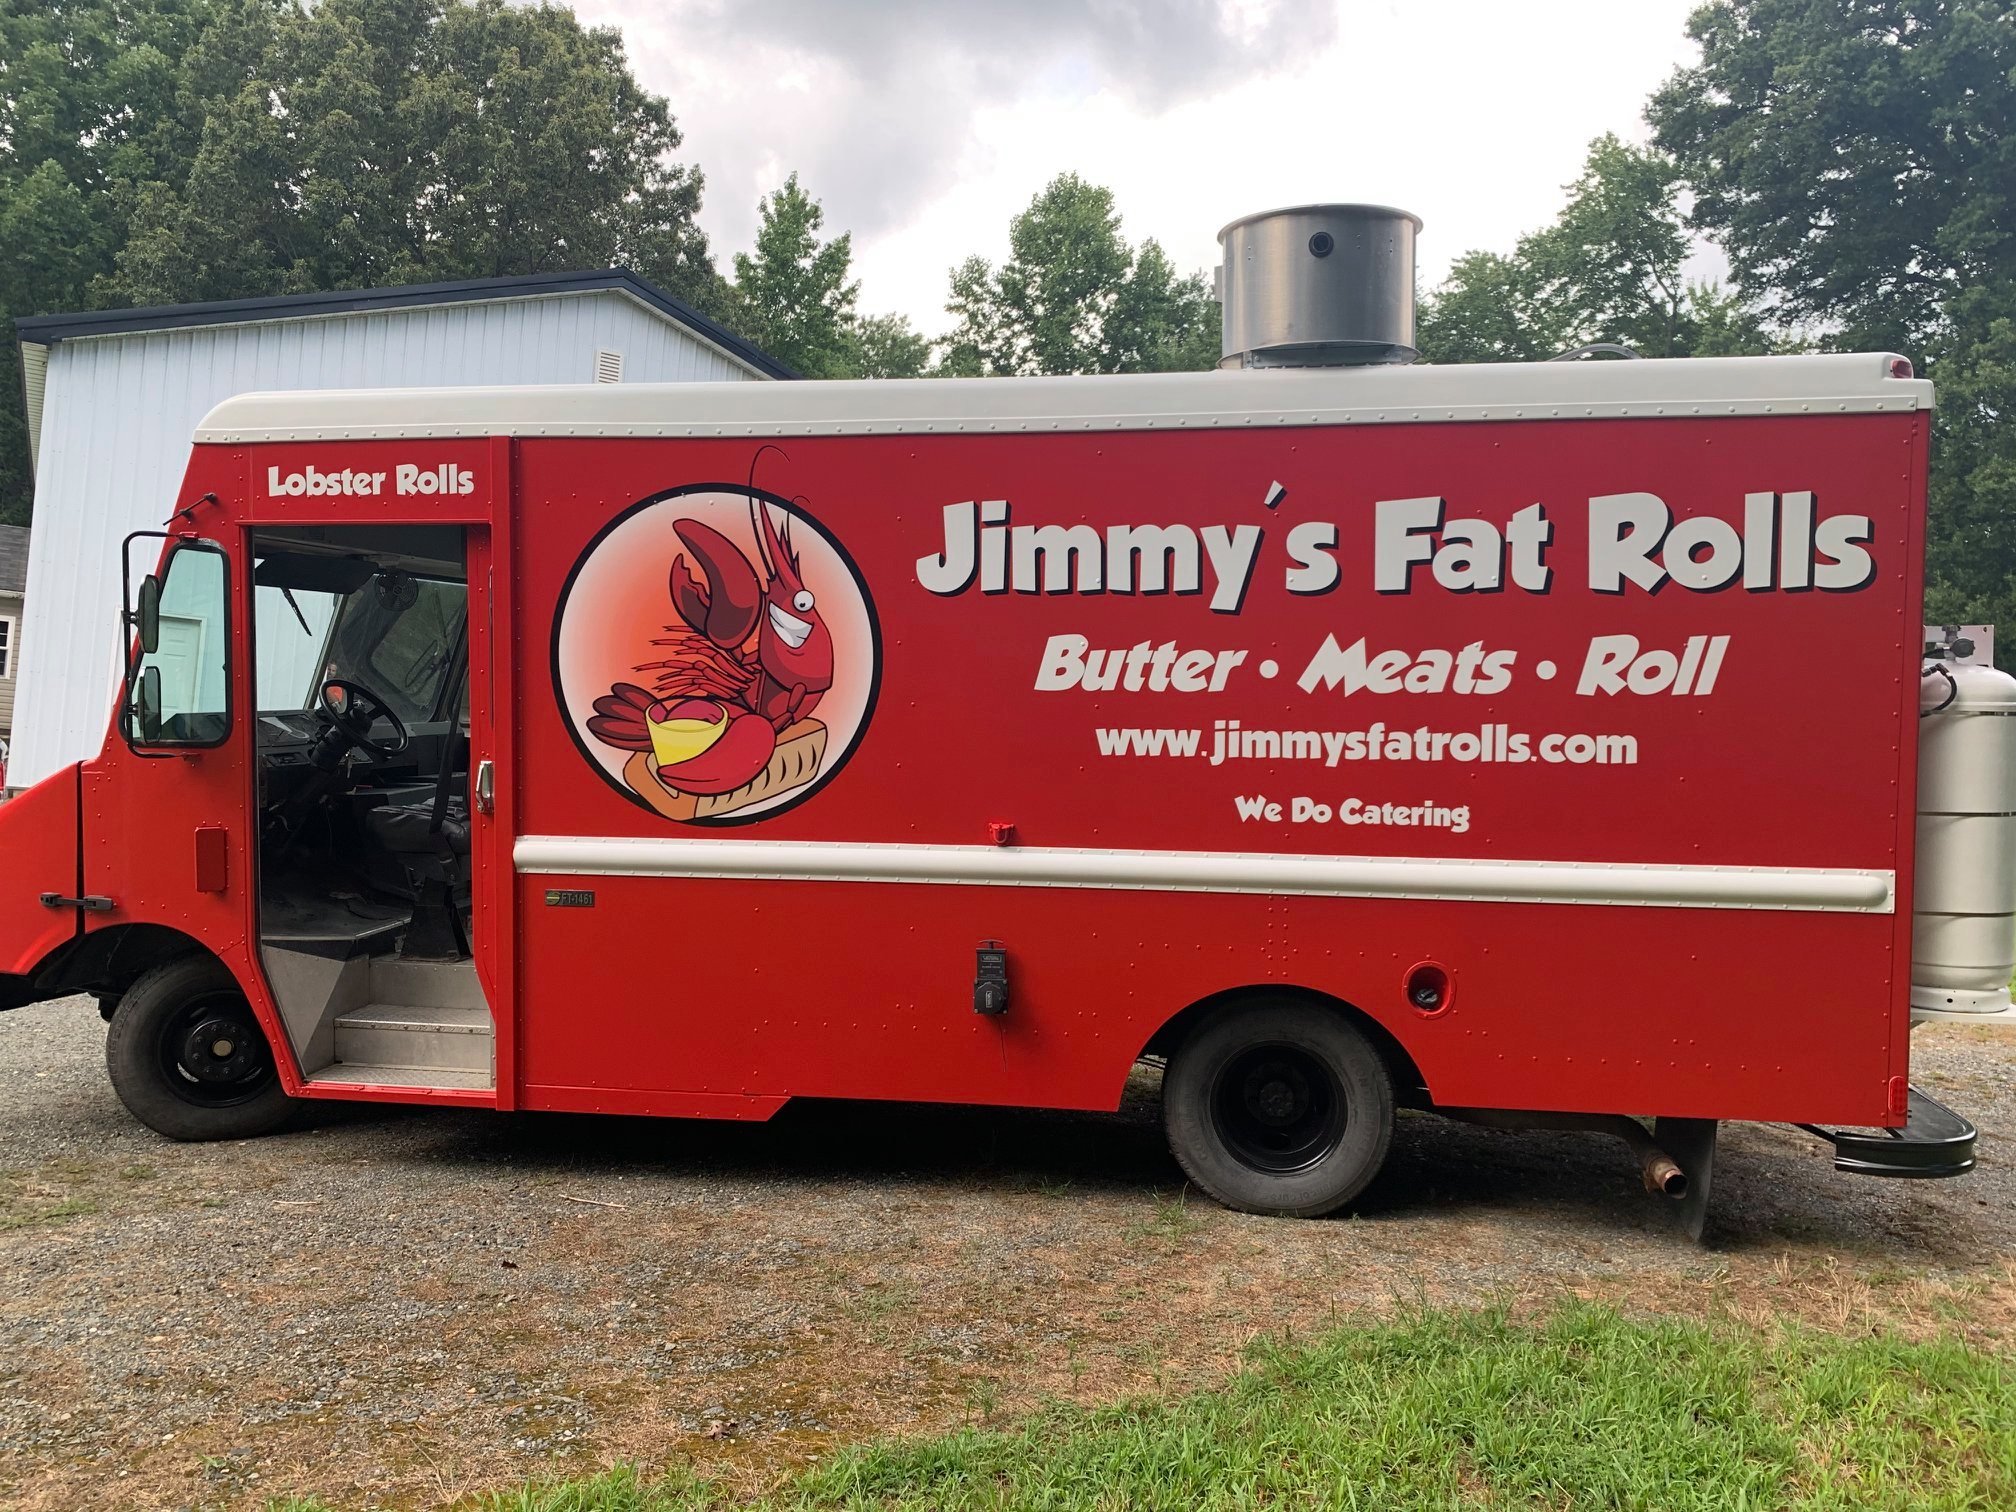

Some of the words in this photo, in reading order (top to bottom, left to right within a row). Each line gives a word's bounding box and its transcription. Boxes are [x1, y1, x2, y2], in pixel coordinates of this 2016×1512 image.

[267, 464, 387, 498] Lobster
[395, 463, 475, 496] Rolls
[915, 480, 1341, 613] Jimmy's
[1374, 496, 1552, 594] Fat
[1587, 490, 1875, 593] Rolls
[1034, 633, 1249, 693] Butter
[1296, 632, 1518, 698] Meats
[1575, 634, 1731, 697] Roll
[1095, 719, 1638, 768] www.jimmysfatrolls.com
[1234, 794, 1283, 824] We
[1291, 796, 1333, 824] Do
[1339, 797, 1470, 833] Catering
